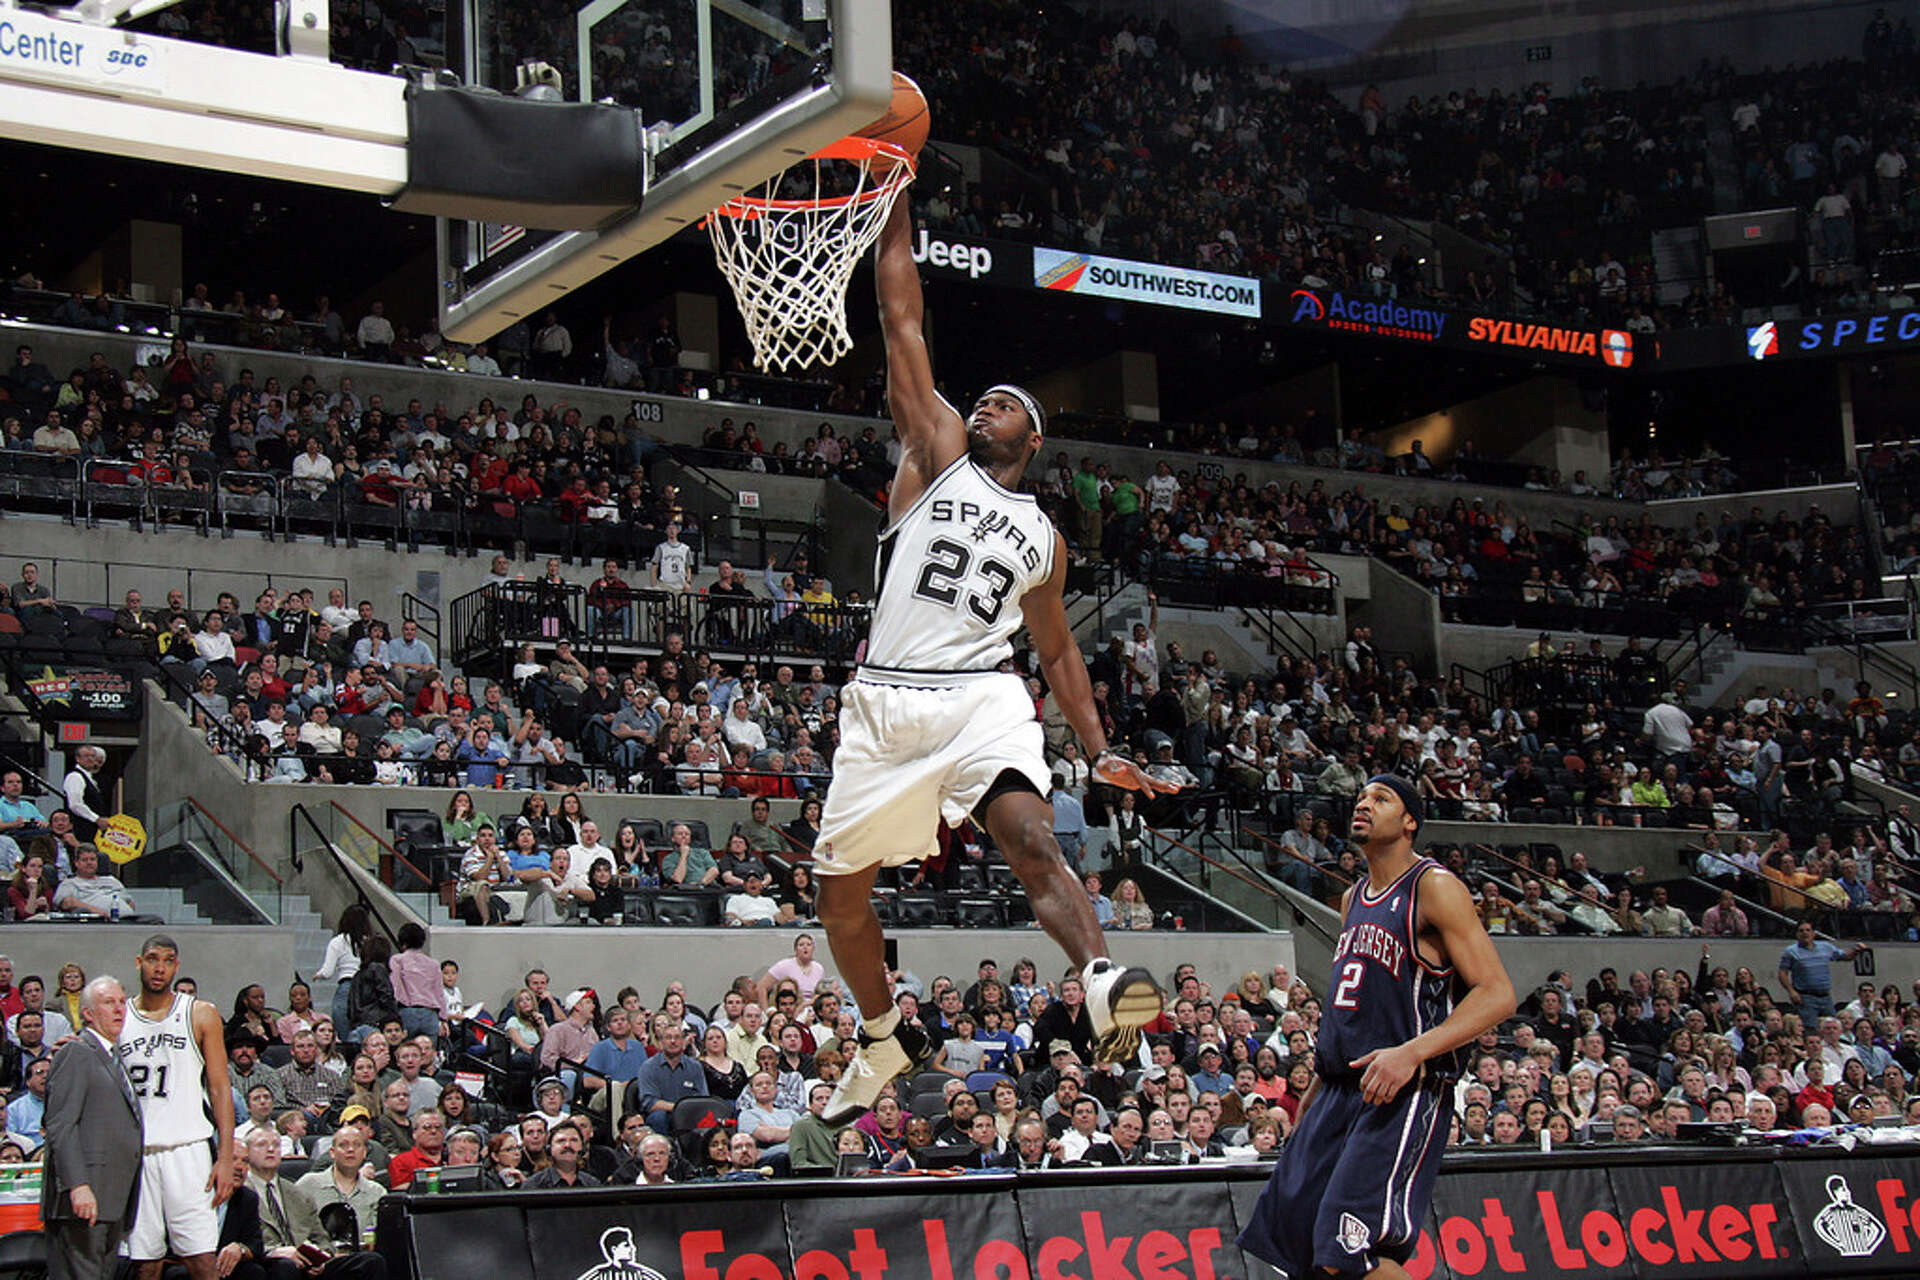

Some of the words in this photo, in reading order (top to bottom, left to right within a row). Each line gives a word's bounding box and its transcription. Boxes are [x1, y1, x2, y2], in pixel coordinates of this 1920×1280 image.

[0, 22, 84, 67] Center
[910, 230, 993, 278] Jeep
[1089, 265, 1256, 306] SOUTHWEST.COM
[1330, 292, 1448, 338] Academy
[1468, 317, 1597, 356] SYLVANIA
[1800, 312, 1920, 350] SPEC
[634, 402, 661, 421] 108
[1200, 465, 1223, 480] 109
[932, 500, 1041, 572] SPURS
[913, 536, 1018, 628] 23
[92, 693, 121, 703] 100
[64, 724, 86, 740] EXIT
[1352, 923, 1405, 976] JERSEY
[1334, 961, 1364, 1008] 2
[120, 1033, 187, 1058] SPURS
[130, 1066, 168, 1098] 21
[922, 1211, 1222, 1280] Locker
[1536, 1186, 1778, 1270] Locker
